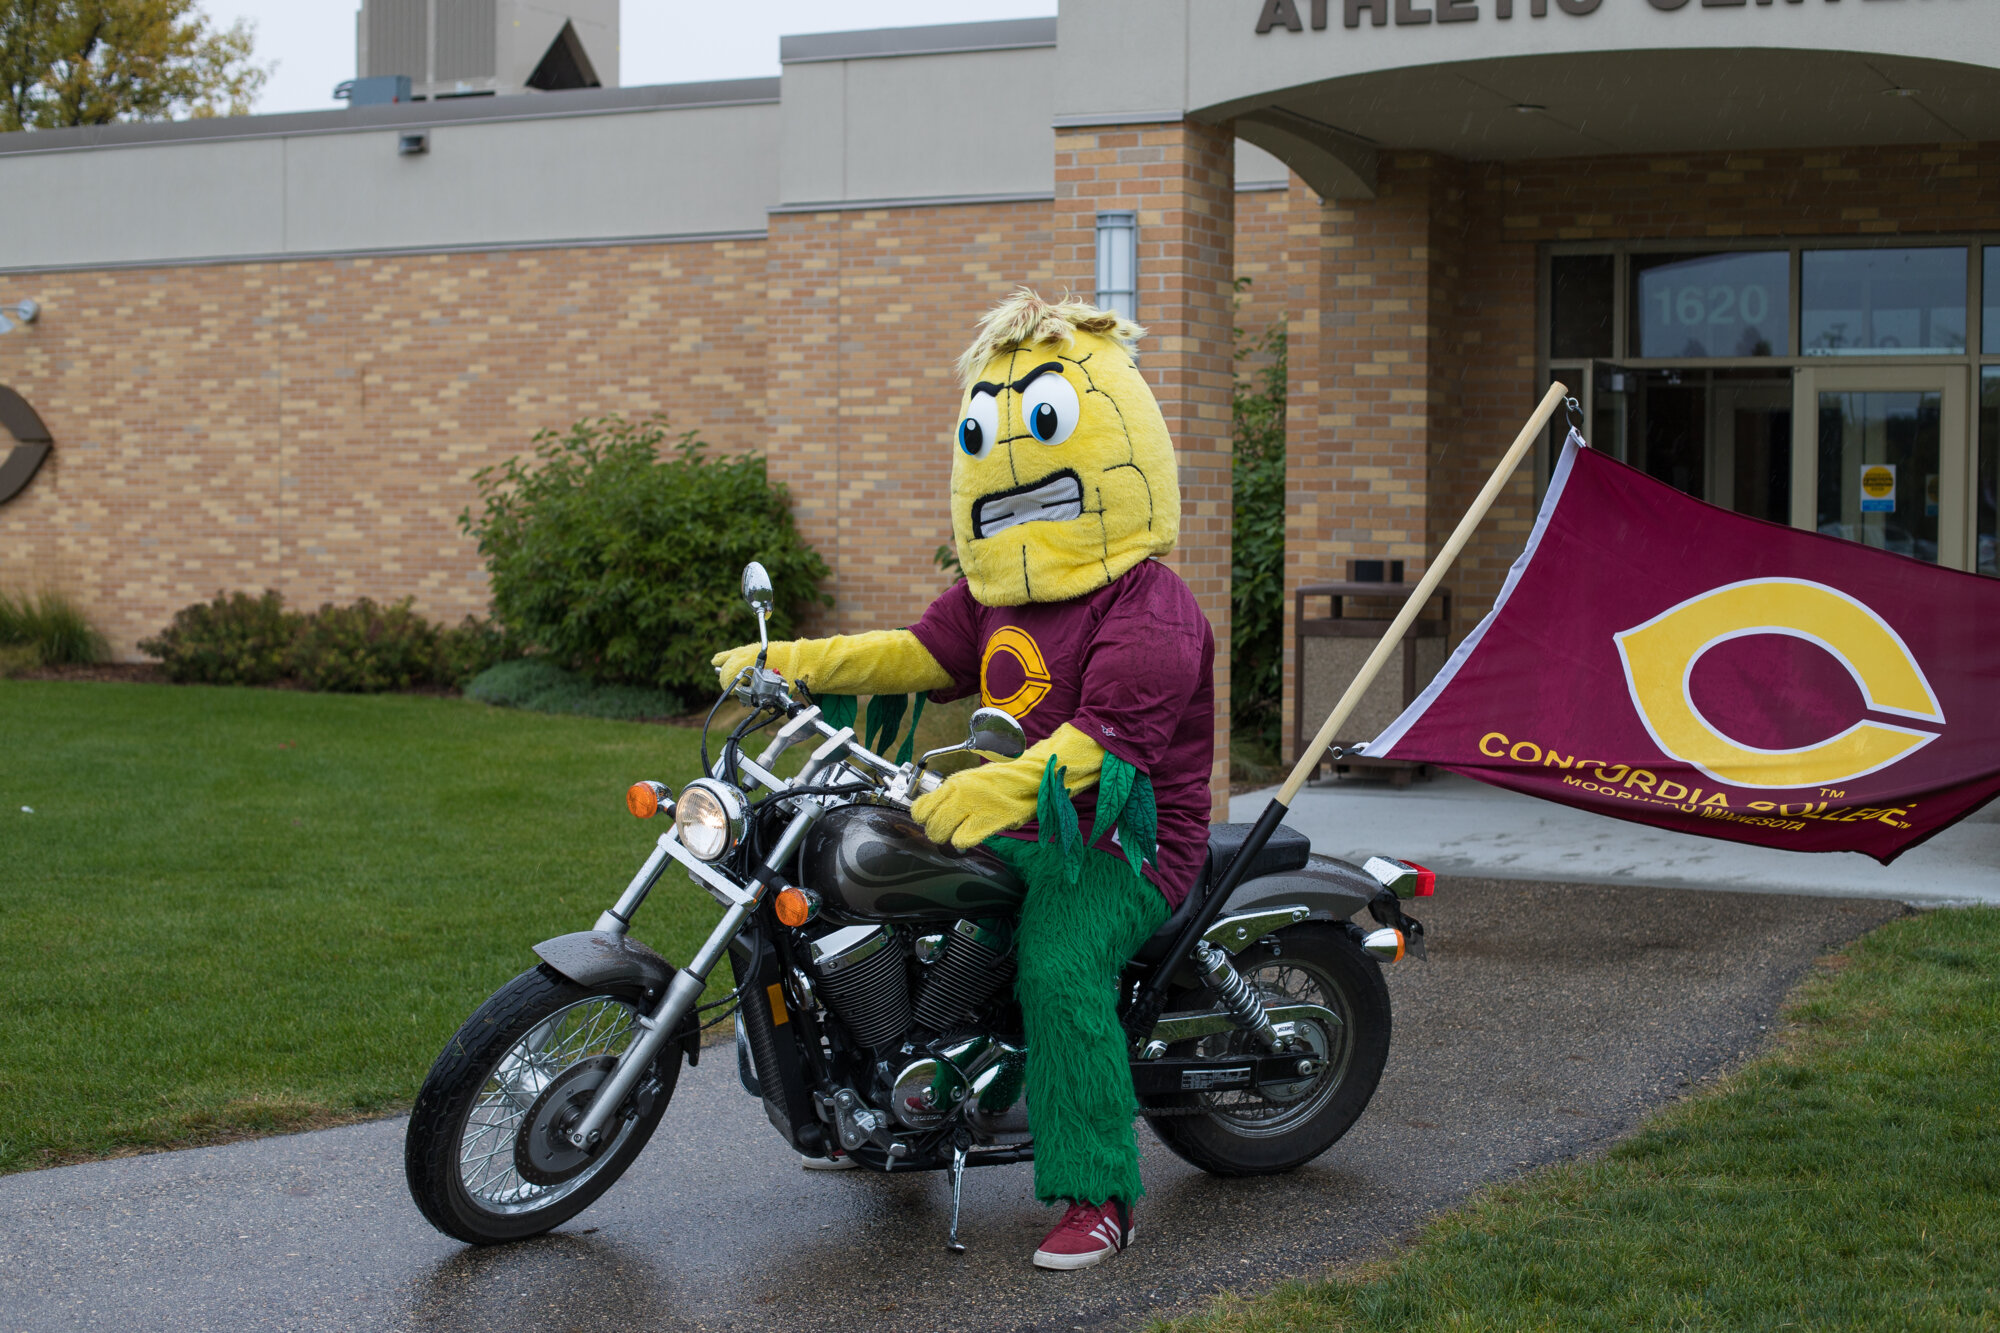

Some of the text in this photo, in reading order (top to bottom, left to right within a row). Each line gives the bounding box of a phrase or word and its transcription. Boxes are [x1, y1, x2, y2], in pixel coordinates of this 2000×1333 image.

[1653, 285, 1769, 326] 1620
[1613, 577, 1946, 789] C
[1562, 774, 1697, 813] MOORD
